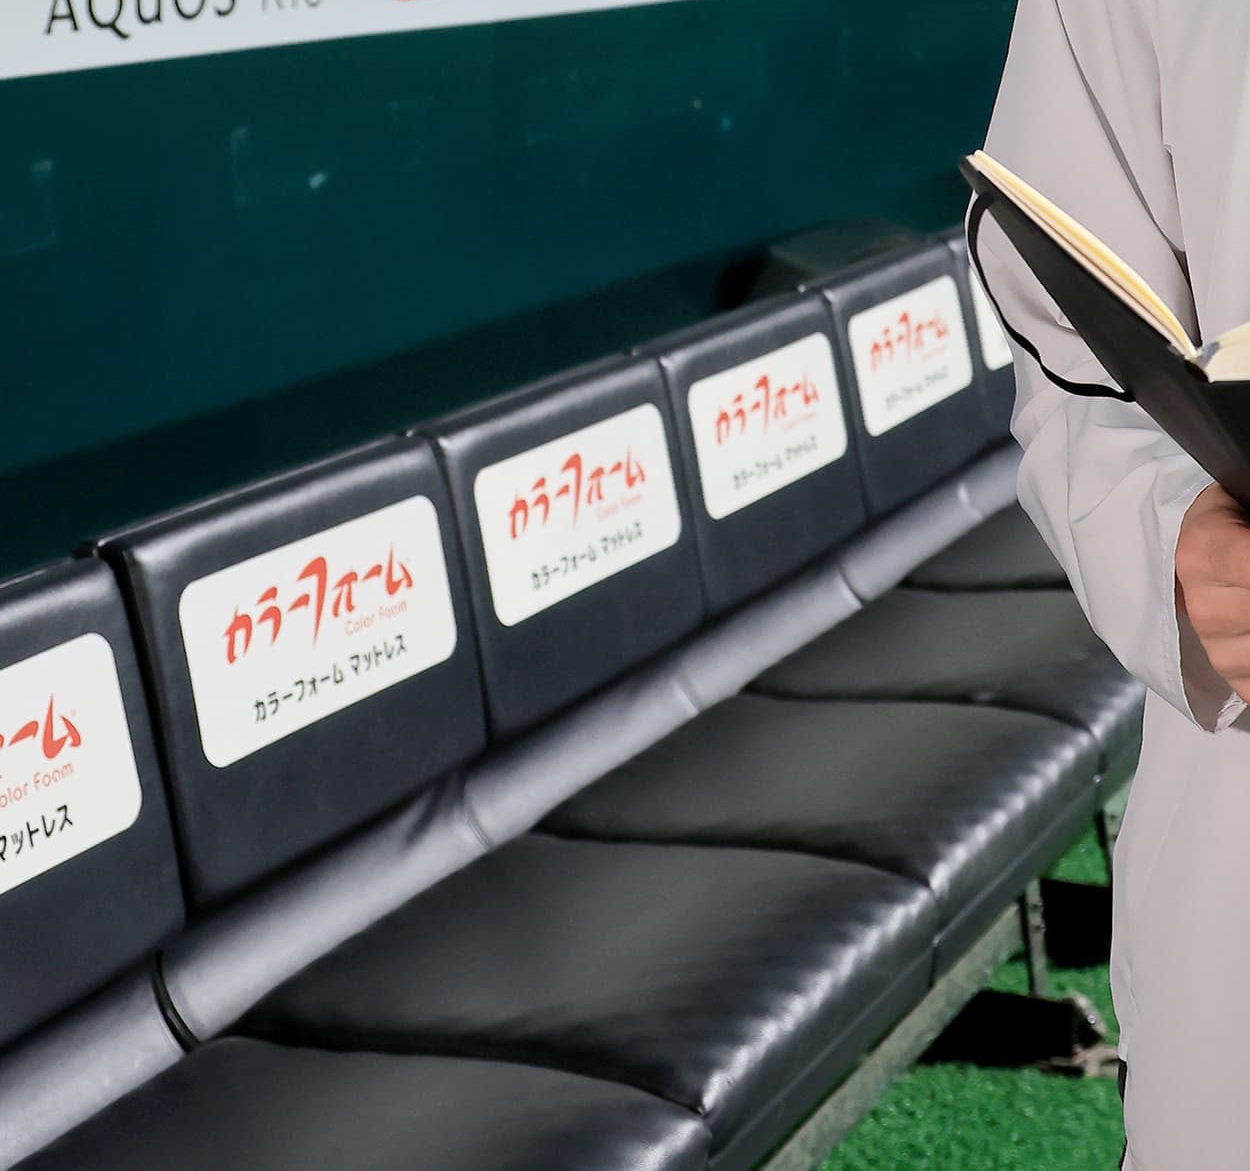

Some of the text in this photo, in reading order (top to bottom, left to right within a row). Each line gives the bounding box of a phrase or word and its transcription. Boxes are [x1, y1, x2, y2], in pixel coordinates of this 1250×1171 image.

[716, 372, 821, 445] カラーフォーム
[508, 445, 647, 540] カラーフォーム
[223, 542, 414, 665] カラーフォーム
[253, 634, 408, 724] カラーフォーム マットレス
[0, 692, 82, 760] ーム
[33, 762, 75, 792] Foam
